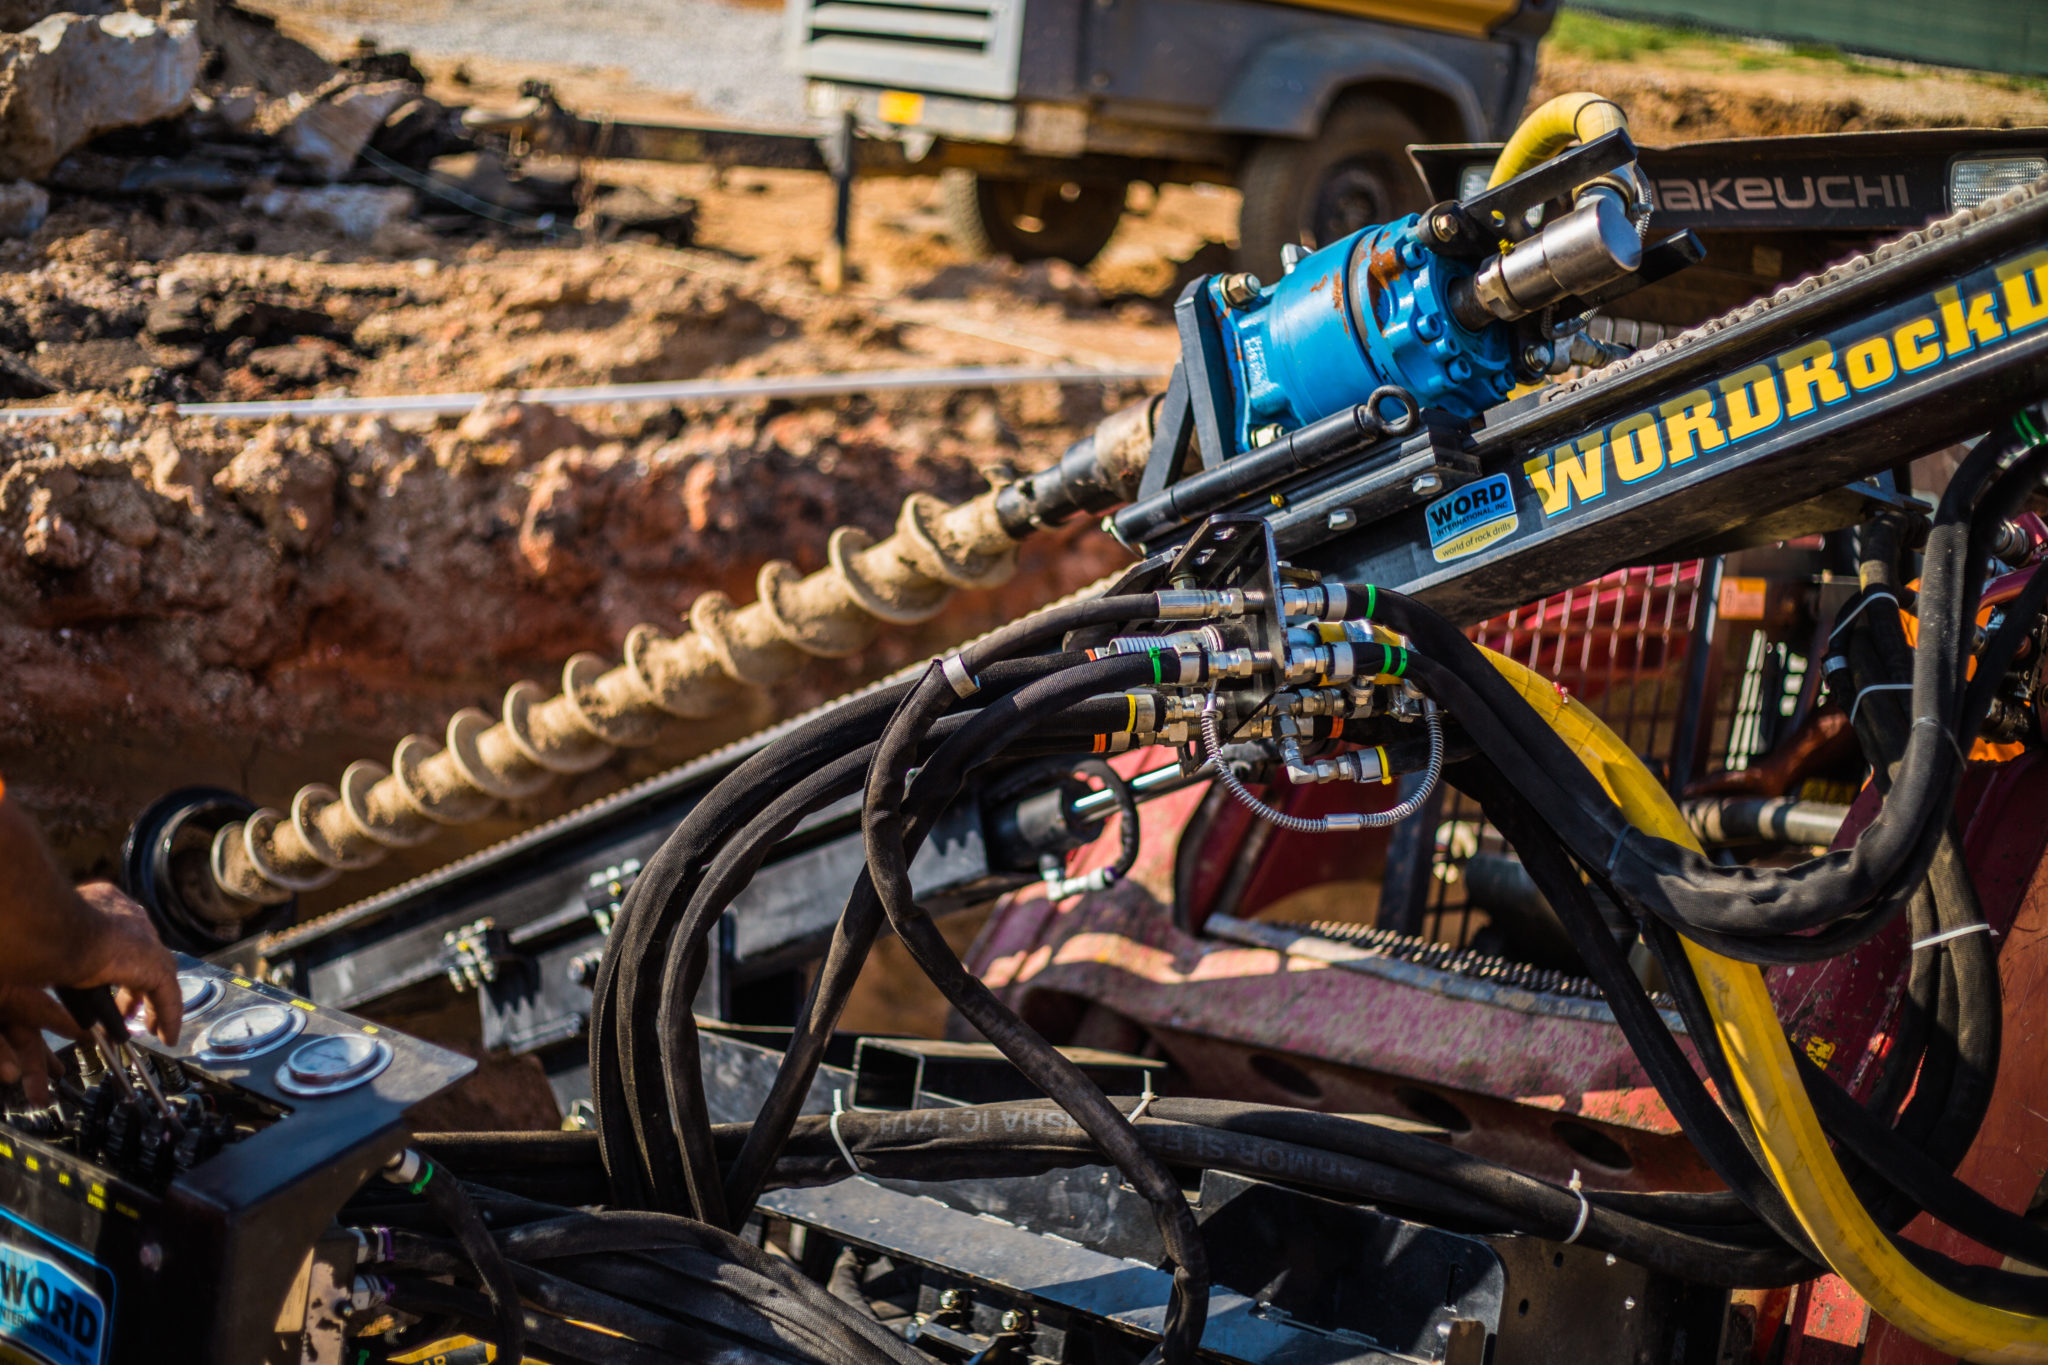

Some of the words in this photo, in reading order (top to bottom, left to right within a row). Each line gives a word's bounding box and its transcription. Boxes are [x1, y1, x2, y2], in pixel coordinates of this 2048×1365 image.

[1430, 482, 1507, 527] WORD
[1442, 544, 1465, 558] world
[1465, 537, 1475, 548] of
[1475, 530, 1492, 544] rock
[1493, 522, 1512, 537] drills
[0, 1259, 97, 1348] WORD
